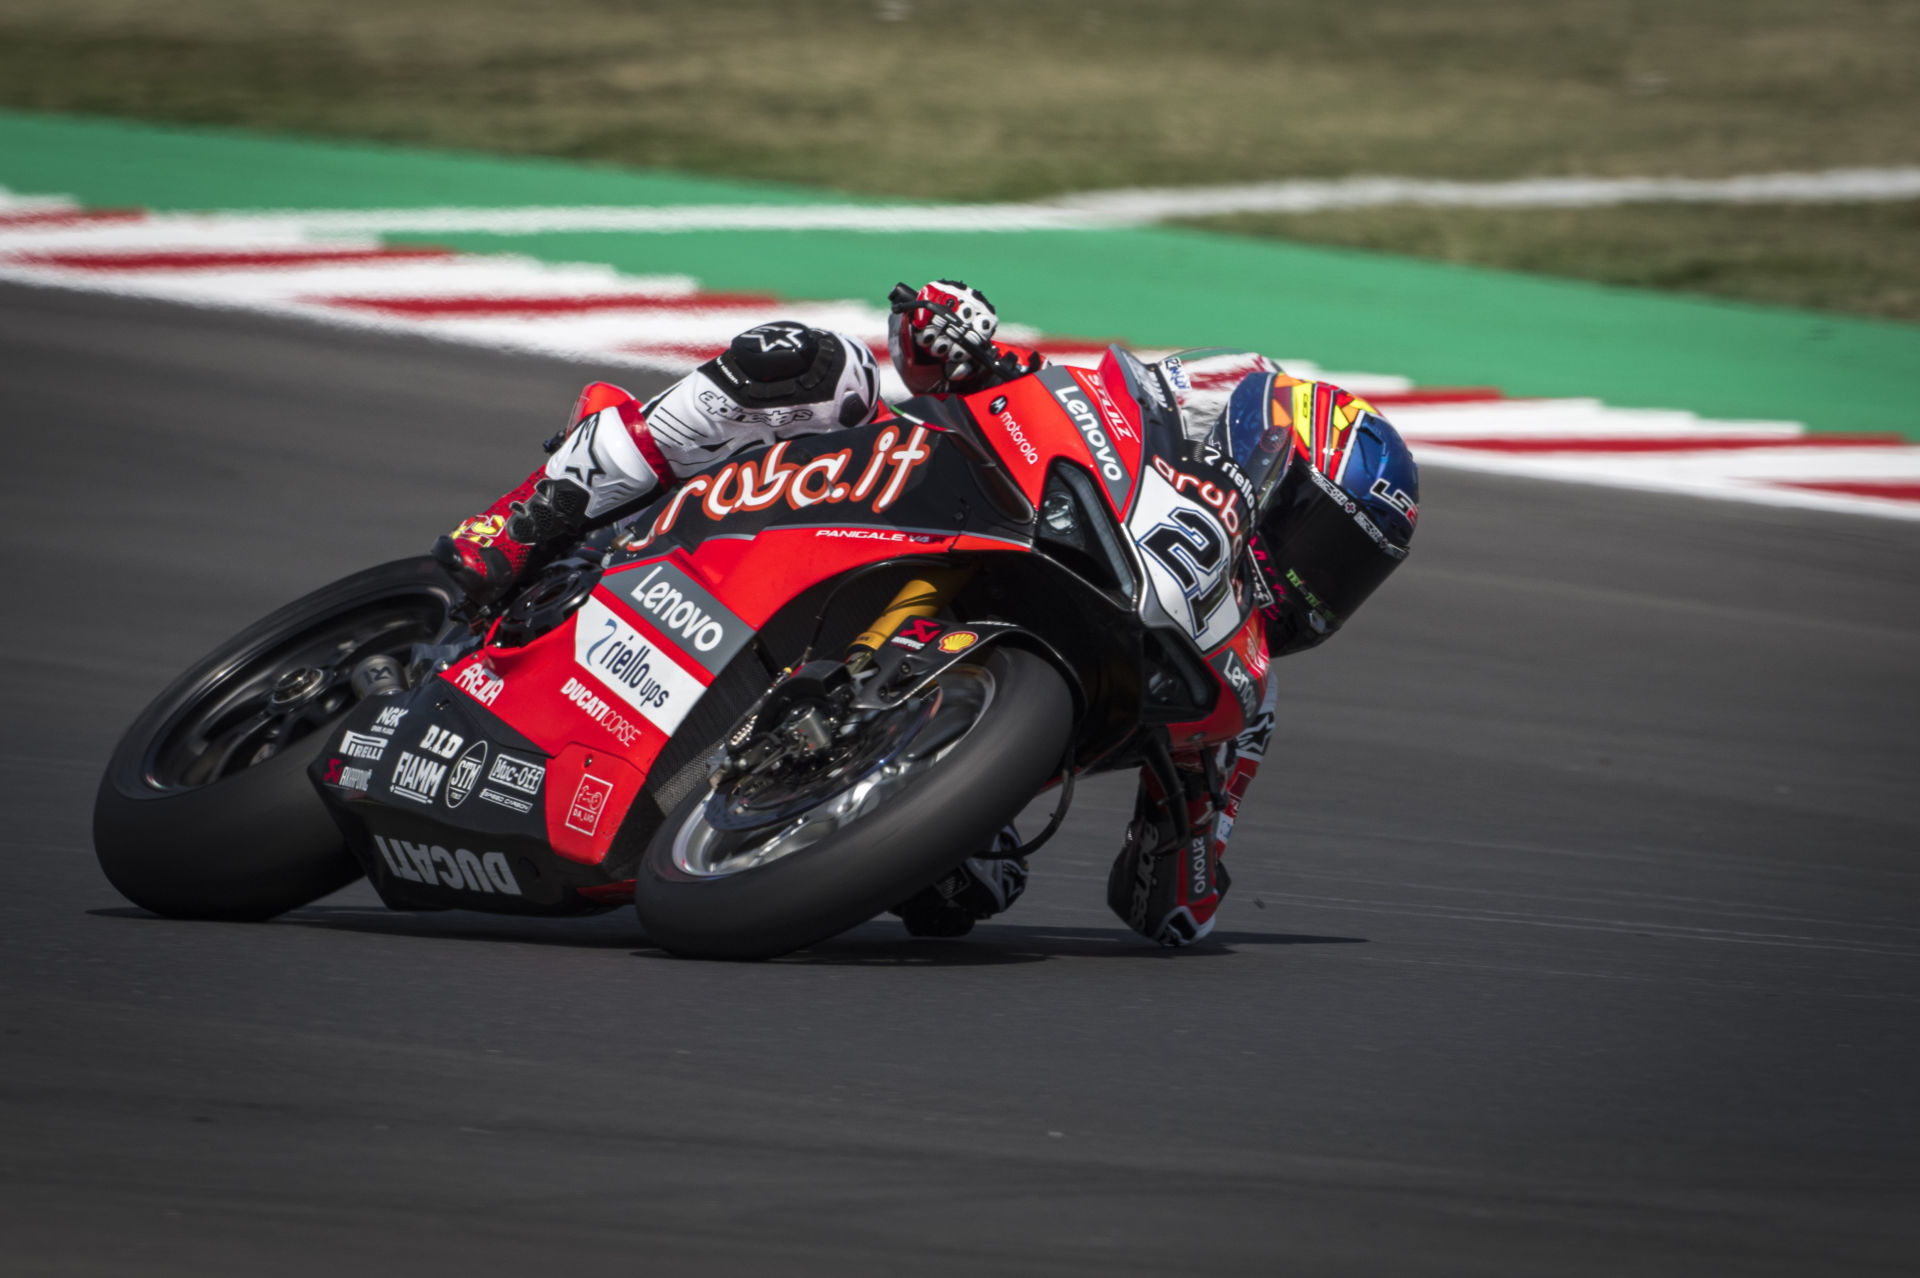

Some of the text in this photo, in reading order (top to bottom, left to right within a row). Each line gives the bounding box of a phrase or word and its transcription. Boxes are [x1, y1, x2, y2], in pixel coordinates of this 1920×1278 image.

[1000, 411, 1039, 465] motorola
[1055, 386, 1122, 482] Lenovo
[1221, 462, 1255, 509] riello
[816, 530, 906, 542] PANIGALE
[1136, 506, 1232, 640] 21
[630, 566, 724, 652] Lenovo
[600, 636, 670, 708] riello ups
[376, 706, 409, 727] NGK
[339, 730, 389, 761] PIRELLI
[420, 724, 464, 759] D.I.D
[392, 751, 448, 797] FIAMM
[450, 760, 481, 793] STM
[492, 759, 544, 790] Muc-Off
[373, 833, 523, 896] DUCATI
